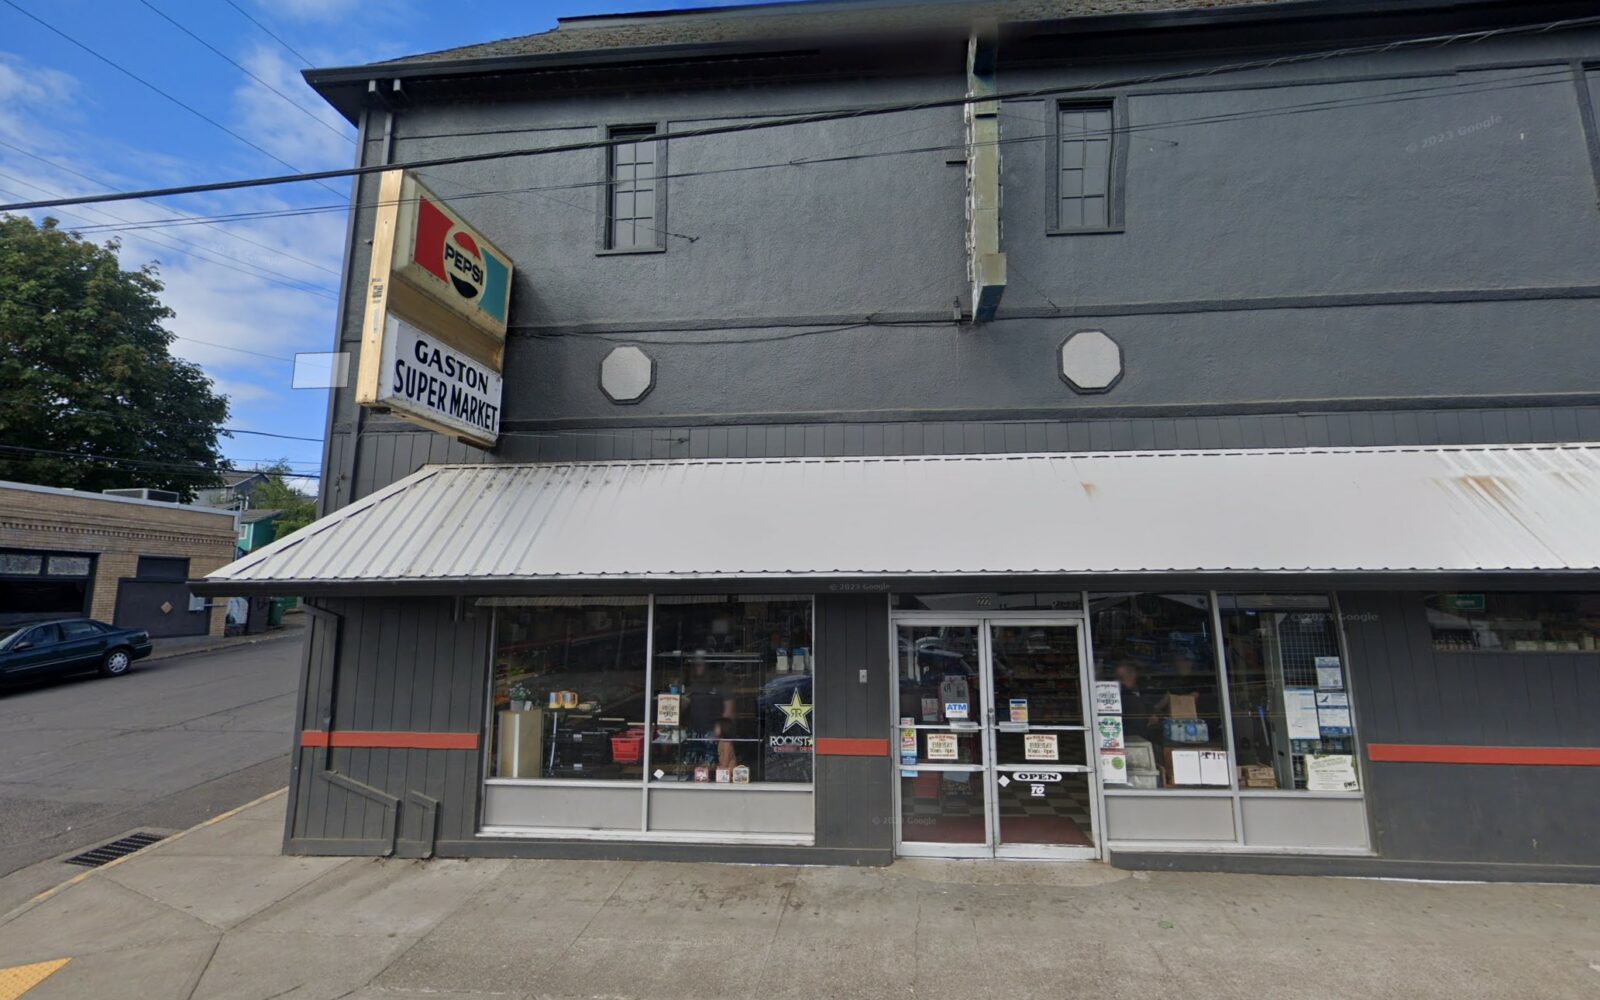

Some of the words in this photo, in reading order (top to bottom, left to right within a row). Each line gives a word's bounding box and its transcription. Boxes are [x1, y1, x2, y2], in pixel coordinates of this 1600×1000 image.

[444, 242, 484, 286] PEPSI
[414, 339, 488, 395] GASTON
[393, 359, 447, 412] SUPER
[450, 383, 498, 432] MARKET
[946, 703, 967, 711] ATM
[1031, 786, 1045, 794] TO
